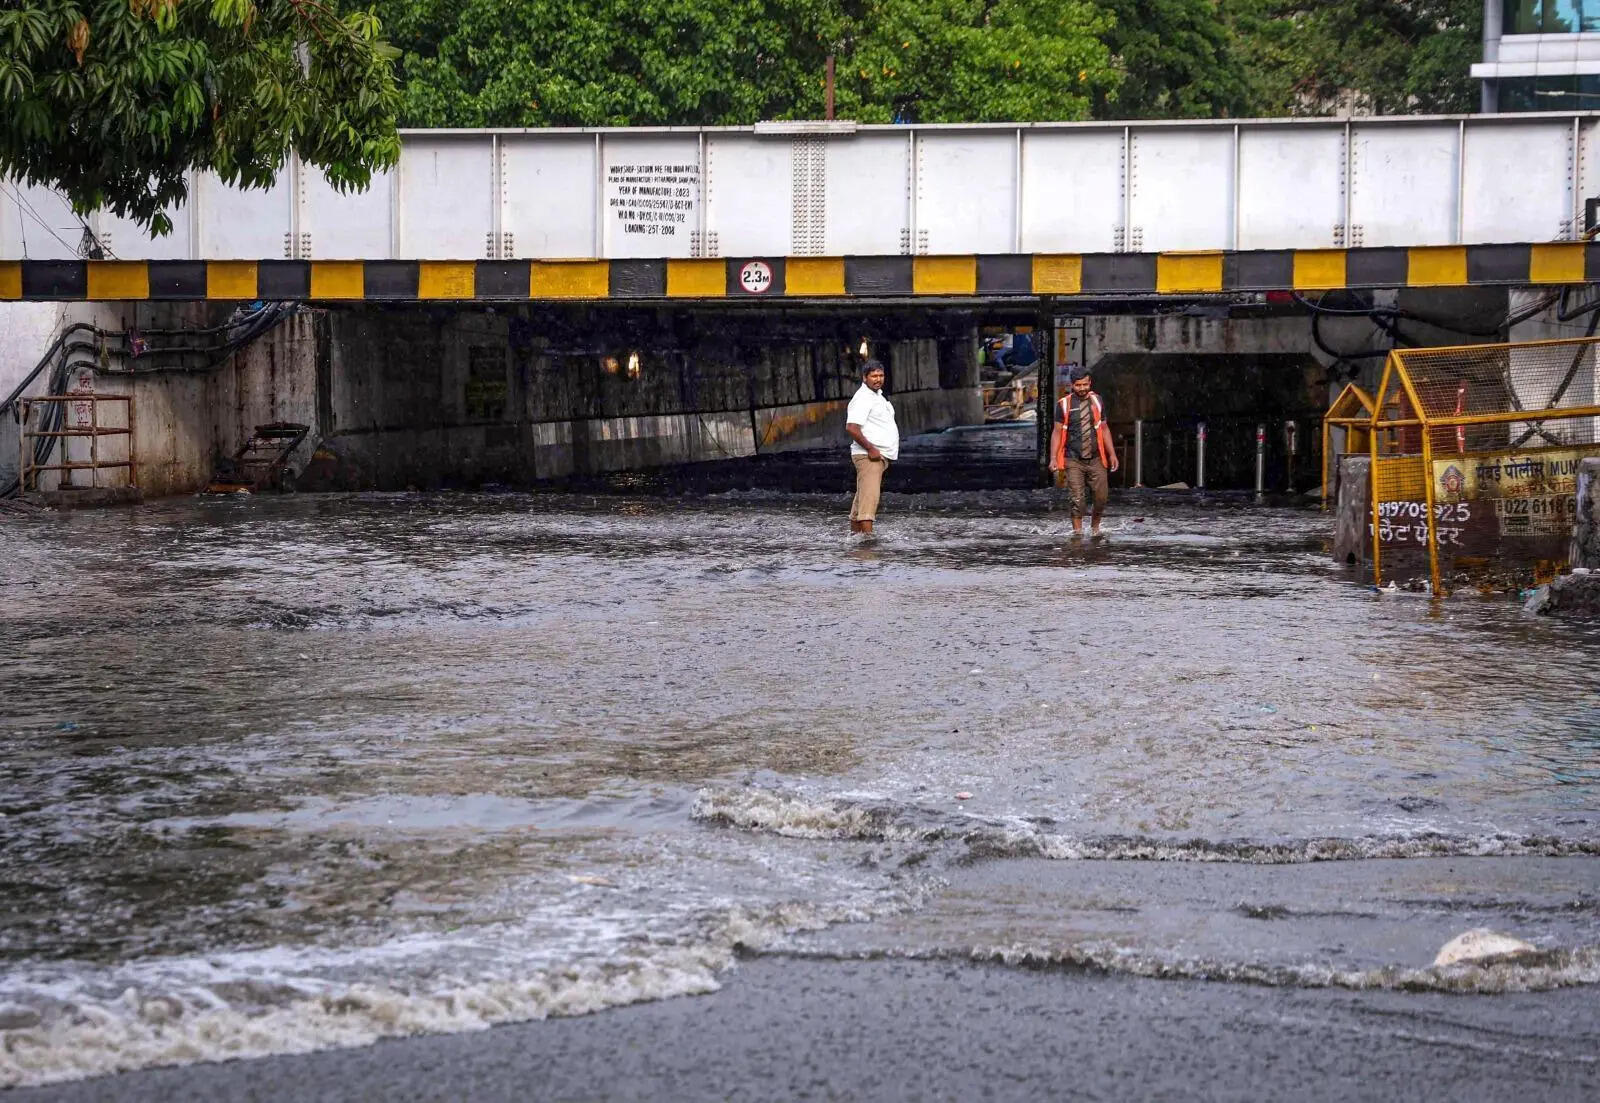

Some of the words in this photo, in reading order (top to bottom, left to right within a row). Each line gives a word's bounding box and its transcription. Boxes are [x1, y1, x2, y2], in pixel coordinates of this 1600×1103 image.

[618, 186, 631, 195] YEAR
[632, 186, 638, 195] OF
[1550, 459, 1581, 476] MUM
[1504, 499, 1529, 514] 022
